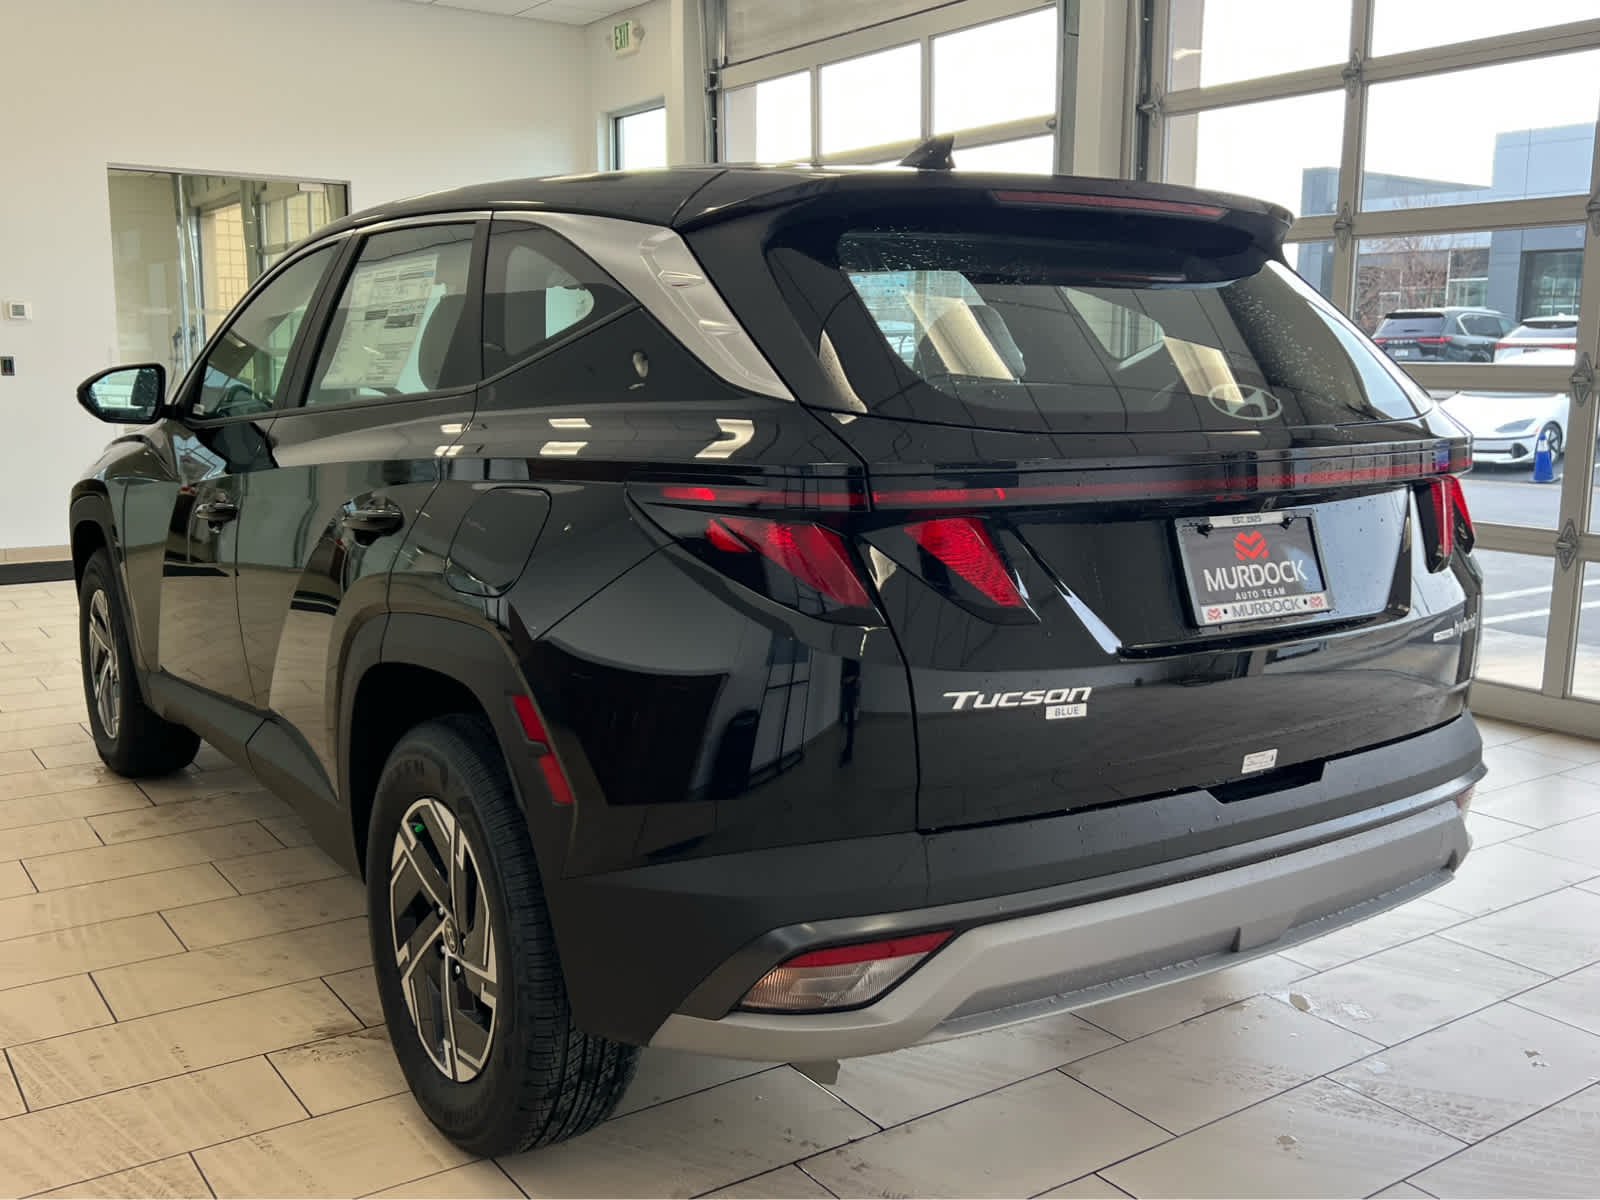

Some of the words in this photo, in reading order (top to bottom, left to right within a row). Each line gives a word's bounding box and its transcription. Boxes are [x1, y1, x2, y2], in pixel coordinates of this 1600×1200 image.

[614, 22, 629, 50] EXIT
[1203, 560, 1308, 592] MURDOCK
[1235, 590, 1258, 600] AUTO
[1262, 587, 1286, 598] TEAM
[1232, 598, 1301, 617] MURDOCK
[1054, 706, 1079, 717] BLUE
